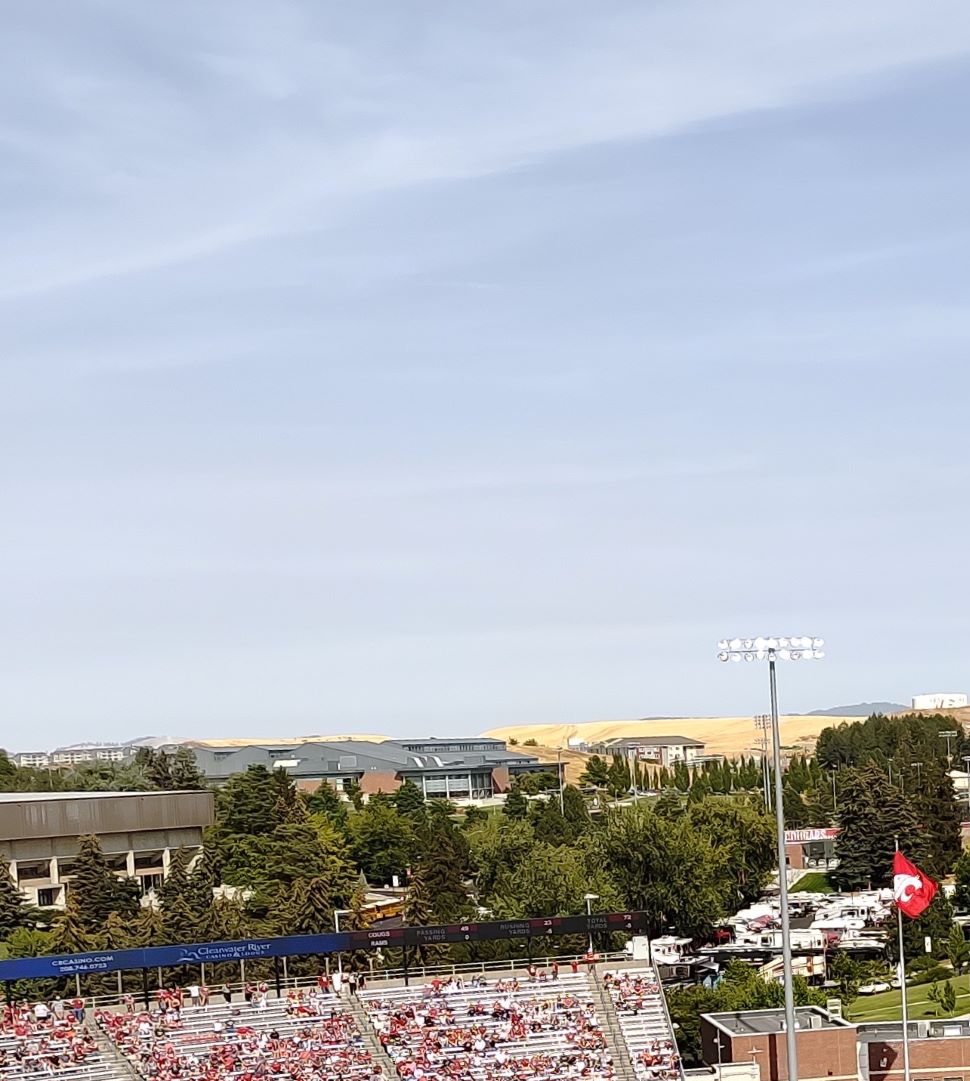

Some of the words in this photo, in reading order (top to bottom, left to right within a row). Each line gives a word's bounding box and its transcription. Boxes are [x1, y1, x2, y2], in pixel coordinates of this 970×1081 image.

[368, 930, 391, 939] COUGS
[197, 946, 247, 955] Clearwater
[247, 943, 271, 951] River
